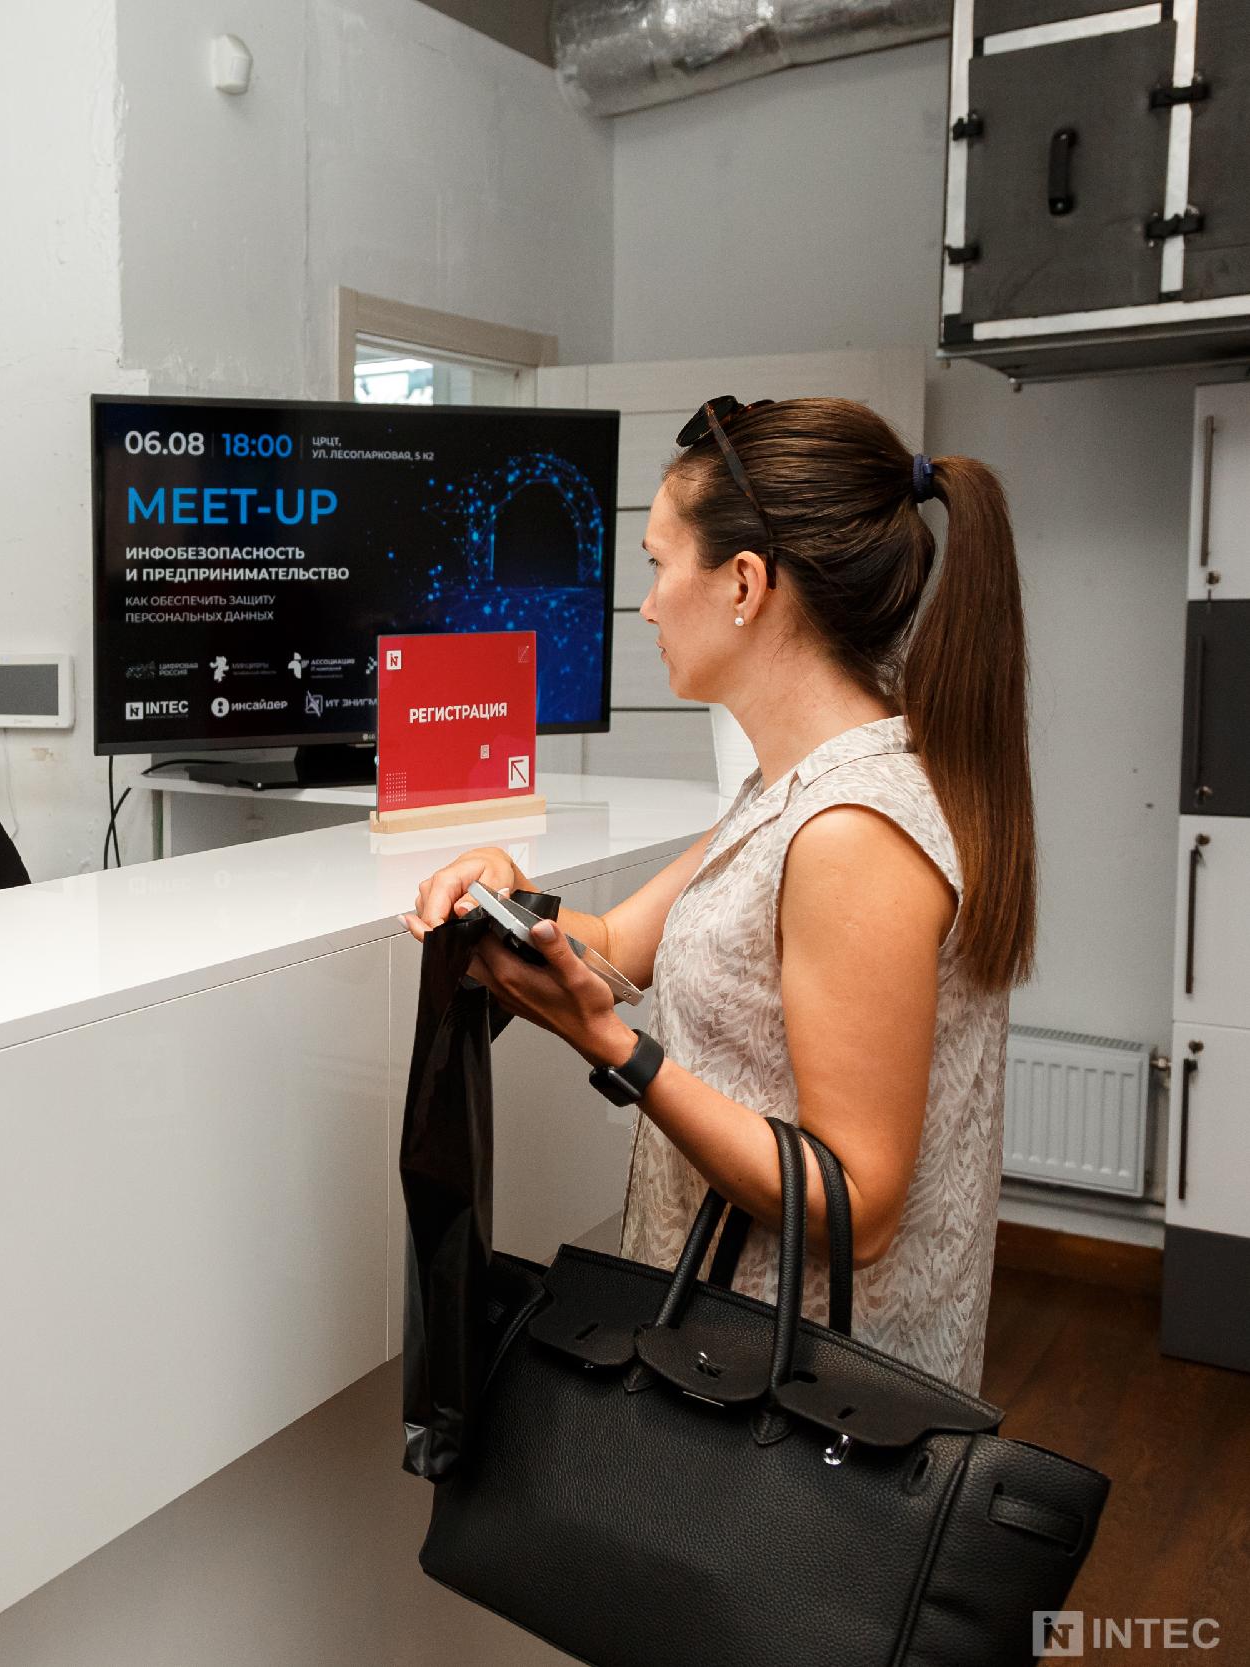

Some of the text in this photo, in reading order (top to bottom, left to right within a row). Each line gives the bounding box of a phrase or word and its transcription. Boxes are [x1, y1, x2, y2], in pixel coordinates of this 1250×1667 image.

[124, 430, 293, 458] 06.08 18:00
[312, 448, 329, 460] УЛ.
[127, 486, 338, 525] MEET-UP
[125, 546, 305, 560] ИНФОБЕЗОПАСНОСТЬ
[125, 567, 350, 583] И ПРЕДПРИНИМАТЕЛЬСТВО
[125, 594, 276, 607] КАК ОБЕСПЕЧИТЬ ЗАЩИТУ
[125, 610, 274, 623] ПЕРСОНАЛЬНЫХ ДАННЫХ
[145, 700, 189, 714] INTEC
[342, 698, 378, 707] ЭНИГМ
[409, 702, 508, 724] РЕГИСТРАЦИЯ
